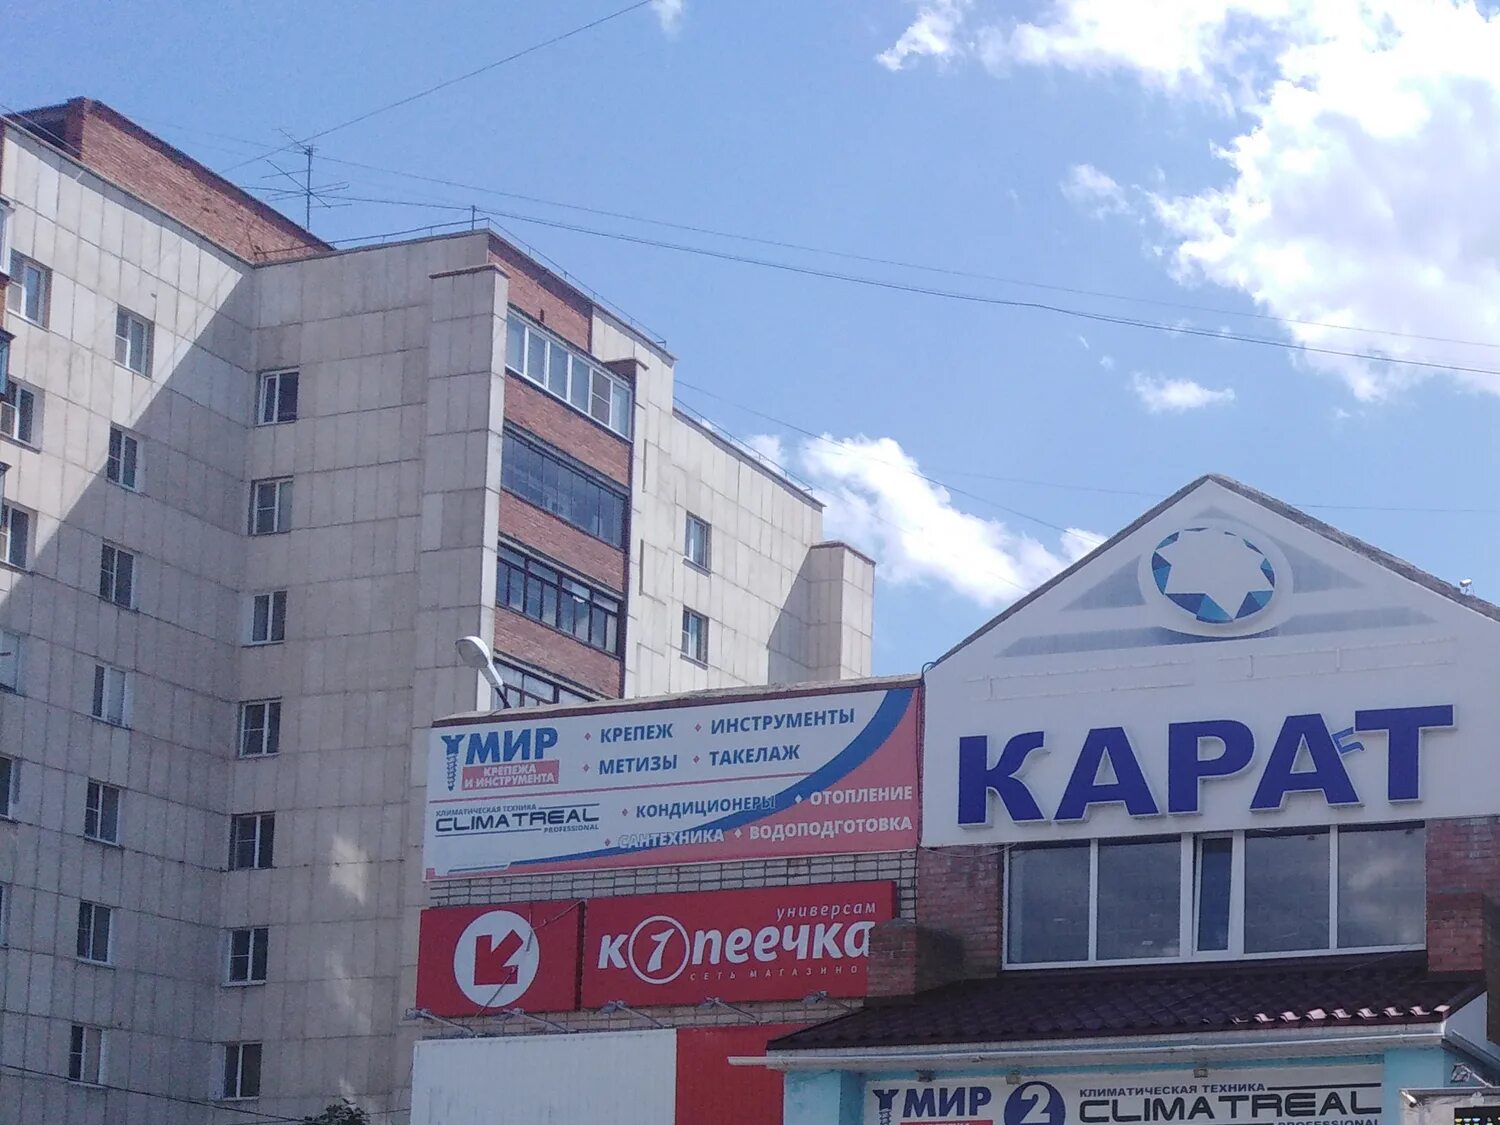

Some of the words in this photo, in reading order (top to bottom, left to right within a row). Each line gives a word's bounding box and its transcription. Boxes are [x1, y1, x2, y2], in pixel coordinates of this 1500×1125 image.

[600, 723, 673, 743] КРЕПЕЖ
[711, 708, 855, 734] ИНСТРУМЕНТЫ
[465, 727, 559, 765] МИР
[599, 754, 678, 775] МЕТИЗЫ
[709, 744, 800, 766] ТАКЕЛАЖ
[483, 764, 536, 777] КРЕПЕЖА
[957, 704, 1454, 825] КАРАТ
[465, 779, 474, 788] И
[476, 774, 554, 788] ИНСТРУМЕНТА
[436, 806, 501, 816] КЛИМАТИЧЕСКАЯ
[503, 804, 537, 812] ТЕХНИКА
[636, 795, 776, 820] КОНДИЦИОНЕРЫ
[810, 786, 913, 806] ОТОПЛЕНИЕ
[435, 808, 600, 832] CLIMATREAL
[544, 824, 599, 833] PROFESSIONAL
[617, 829, 724, 849] САНТЕХНИКА
[750, 816, 913, 841] ВОДОПОДГОТОВКА
[776, 902, 876, 921] универсам
[690, 971, 737, 981] СЕТЬ
[750, 965, 870, 979] МАГАЗИНО
[902, 1086, 992, 1118] МИР
[1020, 1084, 1051, 1124] 2
[1079, 1085, 1198, 1098] КЛИМАТИЧЕСКАЯ
[1201, 1083, 1266, 1093] ТЕХНИКА
[1079, 1091, 1382, 1123] CLIMATREAL
